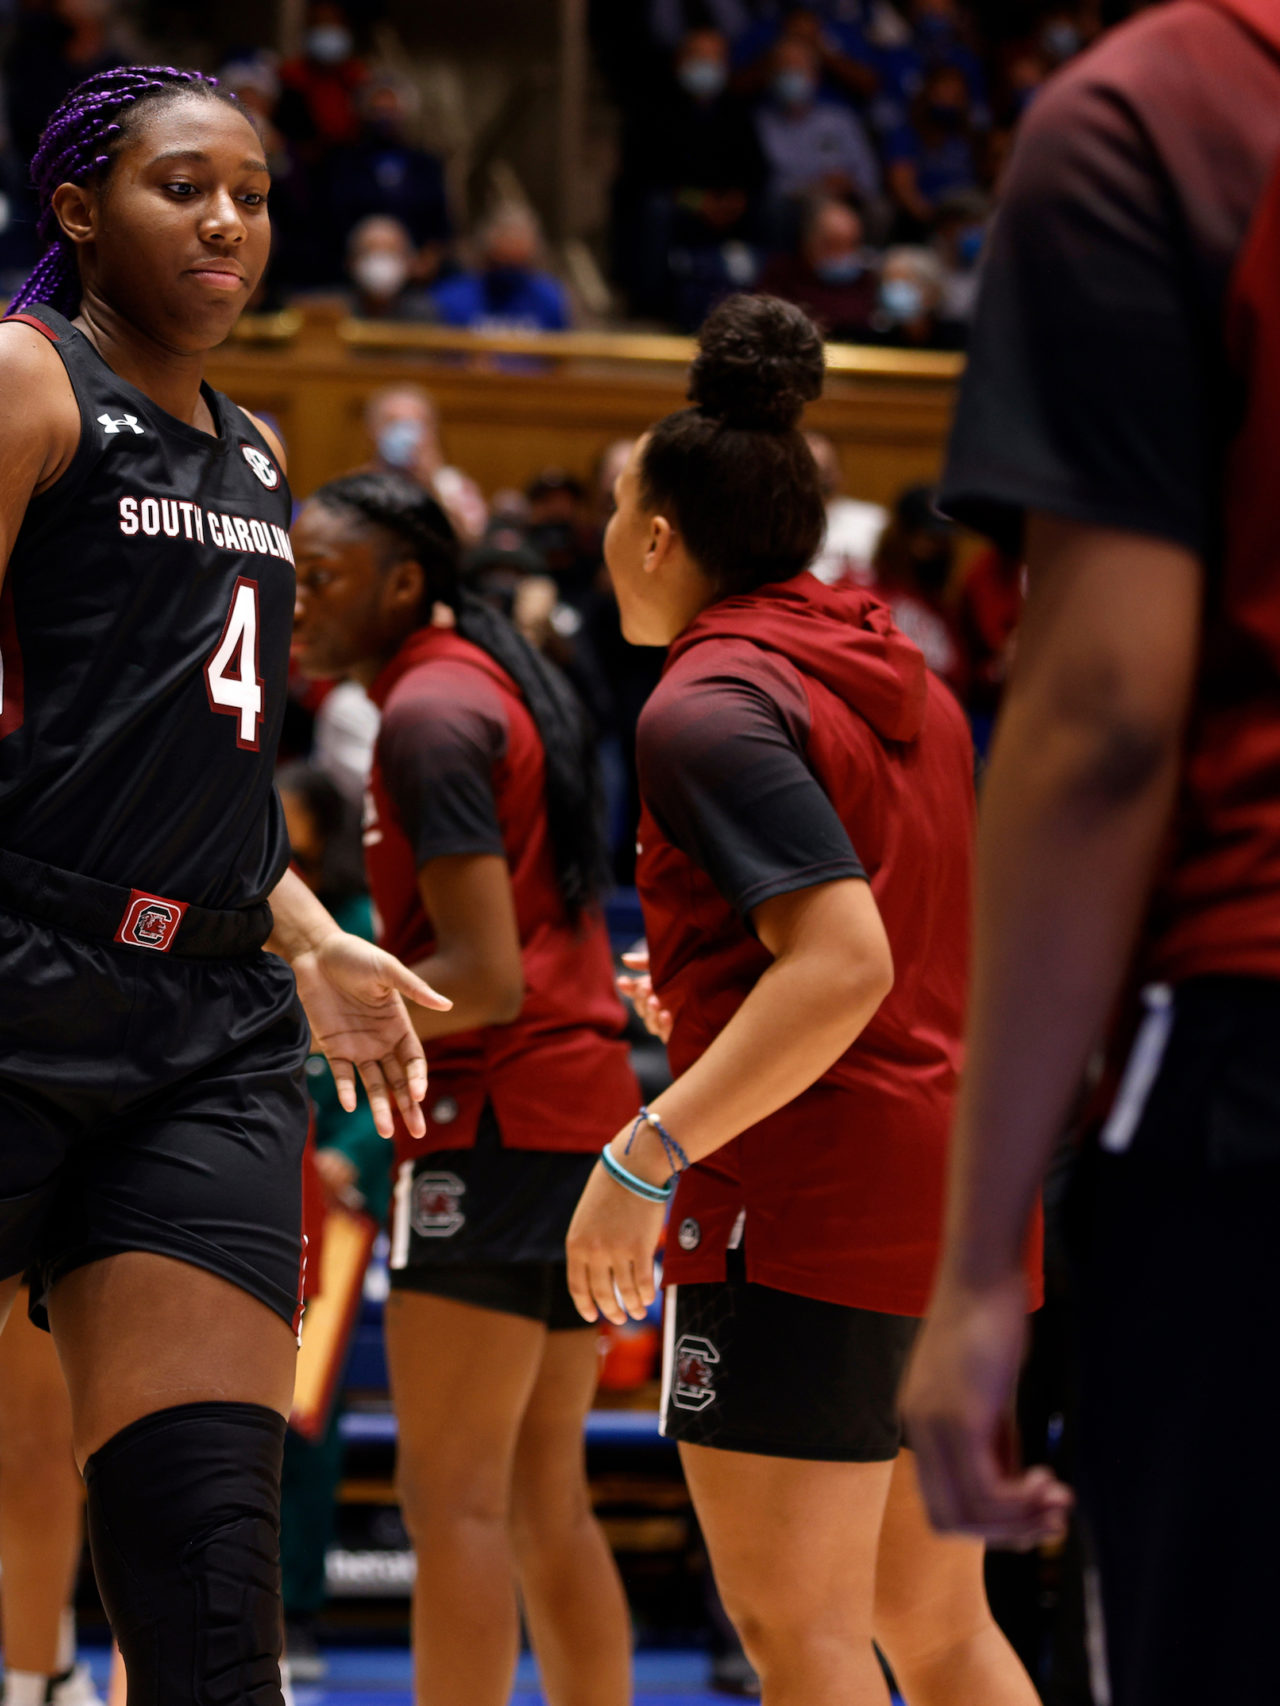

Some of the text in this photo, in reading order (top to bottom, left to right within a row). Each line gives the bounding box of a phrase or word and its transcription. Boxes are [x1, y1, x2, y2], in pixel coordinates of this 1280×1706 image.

[119, 496, 296, 568] SOUTH CAROLIN
[204, 577, 264, 751] 4
